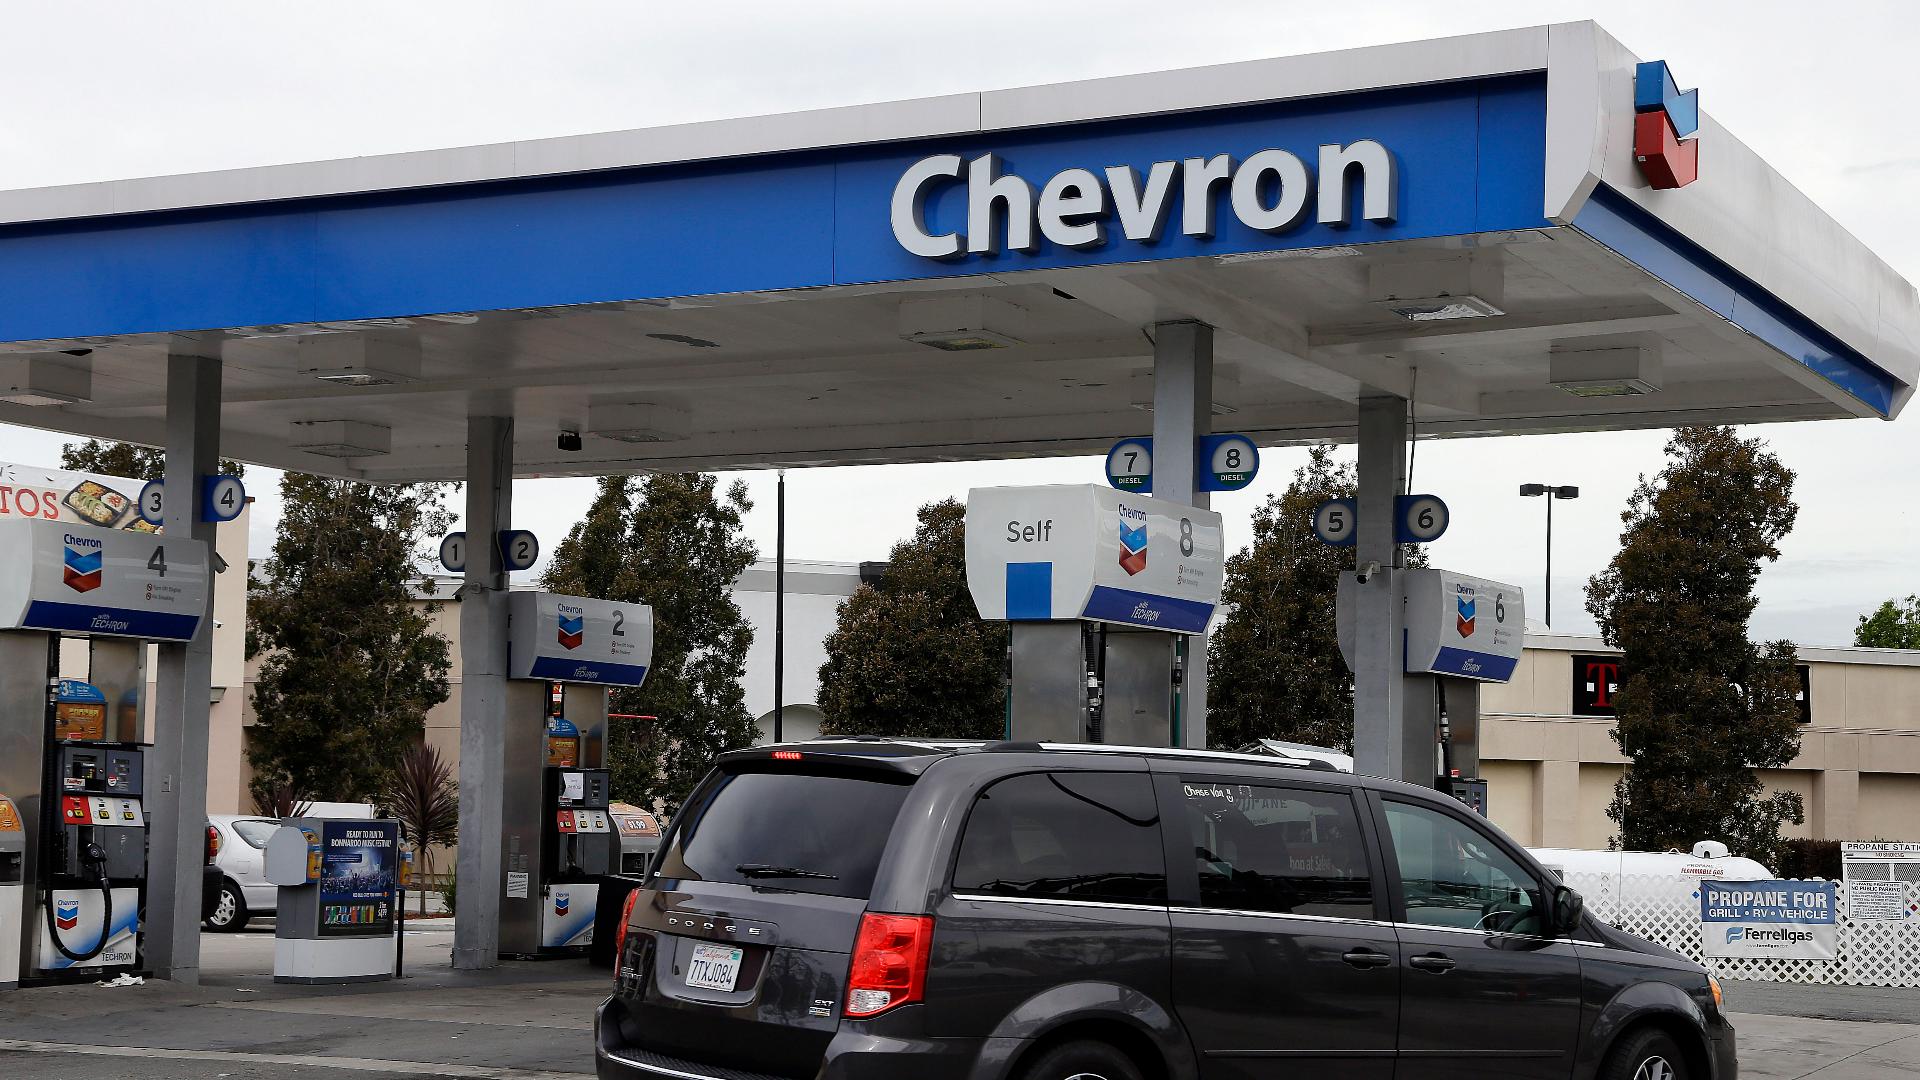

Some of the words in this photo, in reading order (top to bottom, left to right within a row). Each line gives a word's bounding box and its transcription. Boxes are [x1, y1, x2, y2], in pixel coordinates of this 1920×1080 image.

[890, 139, 1398, 260] Chevron
[1124, 451, 1139, 472] 7
[1225, 448, 1241, 469] 8
[1118, 477, 1143, 485] DIESEL
[1220, 474, 1246, 482] DIESEL
[0, 485, 59, 519] TOS
[150, 492, 162, 512] 3
[220, 487, 235, 509] 4
[1118, 503, 1147, 521] Chevron
[1327, 511, 1344, 532] 5
[1417, 508, 1434, 529] 6
[63, 533, 102, 549] Chevron
[1006, 519, 1053, 543] Self
[1180, 517, 1194, 557] 8
[451, 543, 458, 561] 1
[517, 541, 529, 559] 2
[147, 545, 168, 577] 4
[557, 602, 583, 614] Chevron
[1495, 593, 1505, 623] 6
[90, 617, 129, 631] TECHRON
[612, 609, 625, 636] 2
[1708, 890, 1788, 907] PROPANE
[1793, 892, 1828, 909] FOR
[1708, 908, 1741, 918] GRILL
[1753, 909, 1767, 918] RV
[1779, 909, 1828, 919] VEHICLE
[668, 918, 762, 935] DODGE
[1745, 928, 1813, 944] Ferrellgas
[102, 953, 132, 962] TECHRON
[691, 960, 733, 984] 7TXJ084
